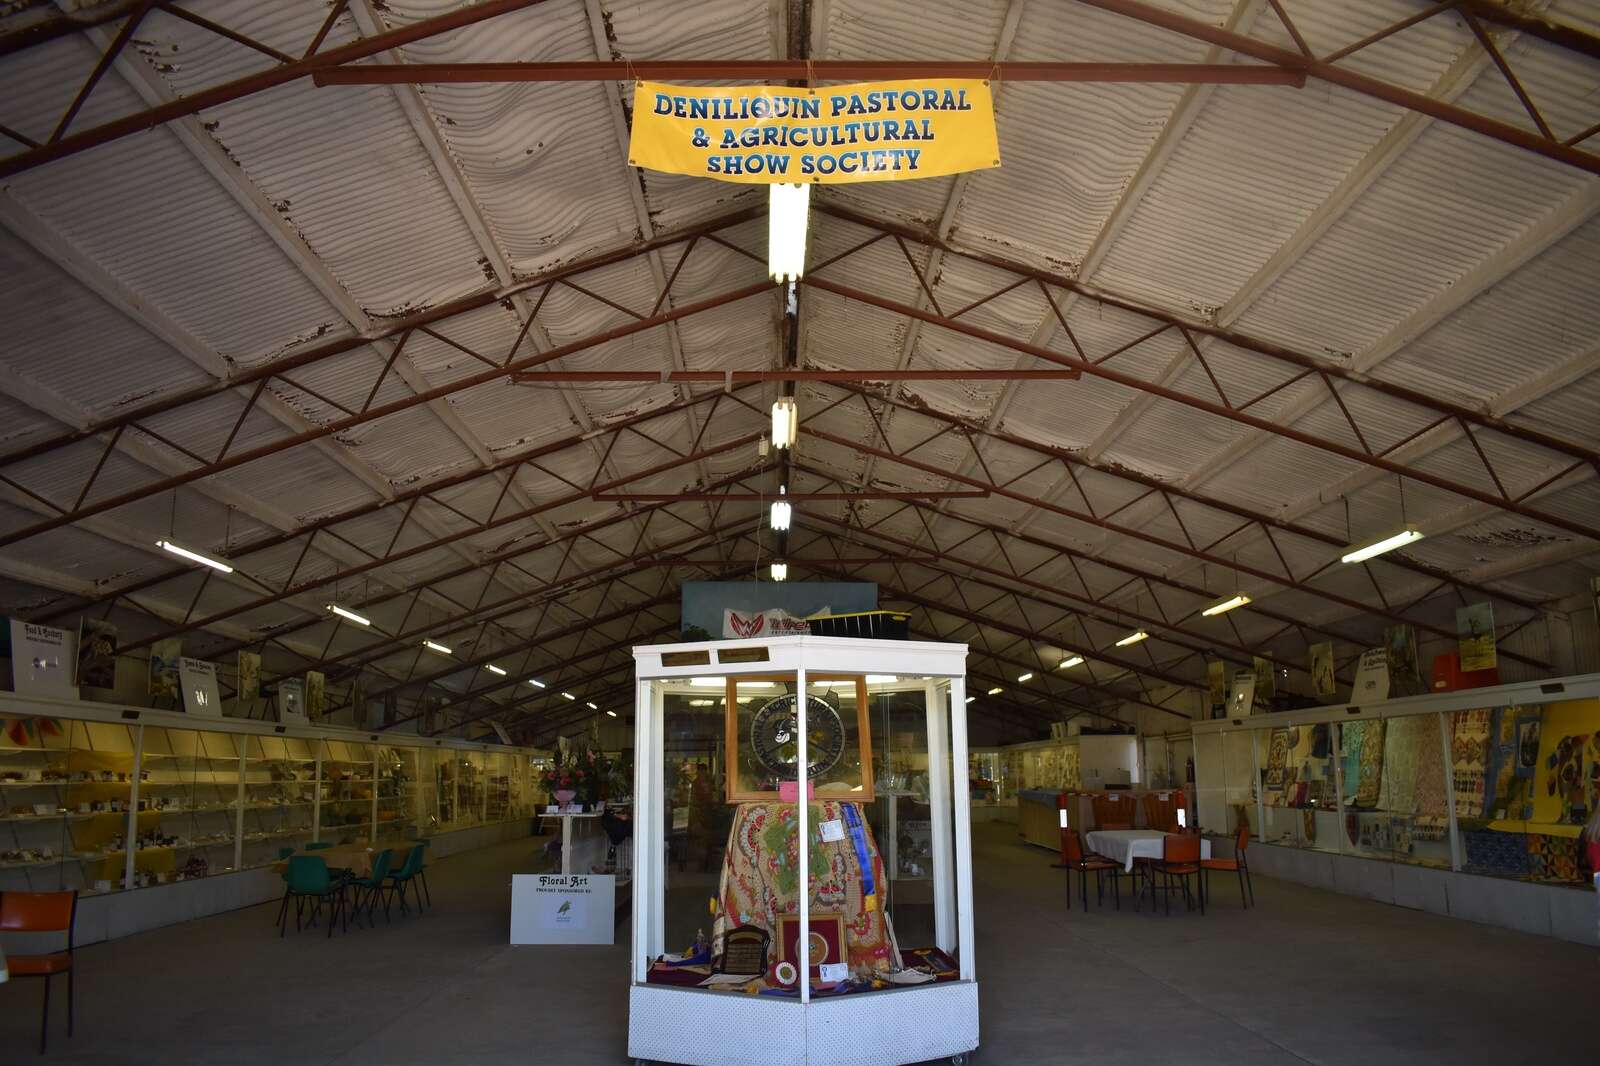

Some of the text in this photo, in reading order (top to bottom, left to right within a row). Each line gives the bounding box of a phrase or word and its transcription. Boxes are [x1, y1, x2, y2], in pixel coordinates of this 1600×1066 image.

[653, 89, 972, 120] DENILIQUIN PASTORAL
[691, 119, 935, 149] & AGRICULTURAL
[707, 149, 922, 175] SHOW SOCIETY
[539, 876, 588, 887] Floral Art
